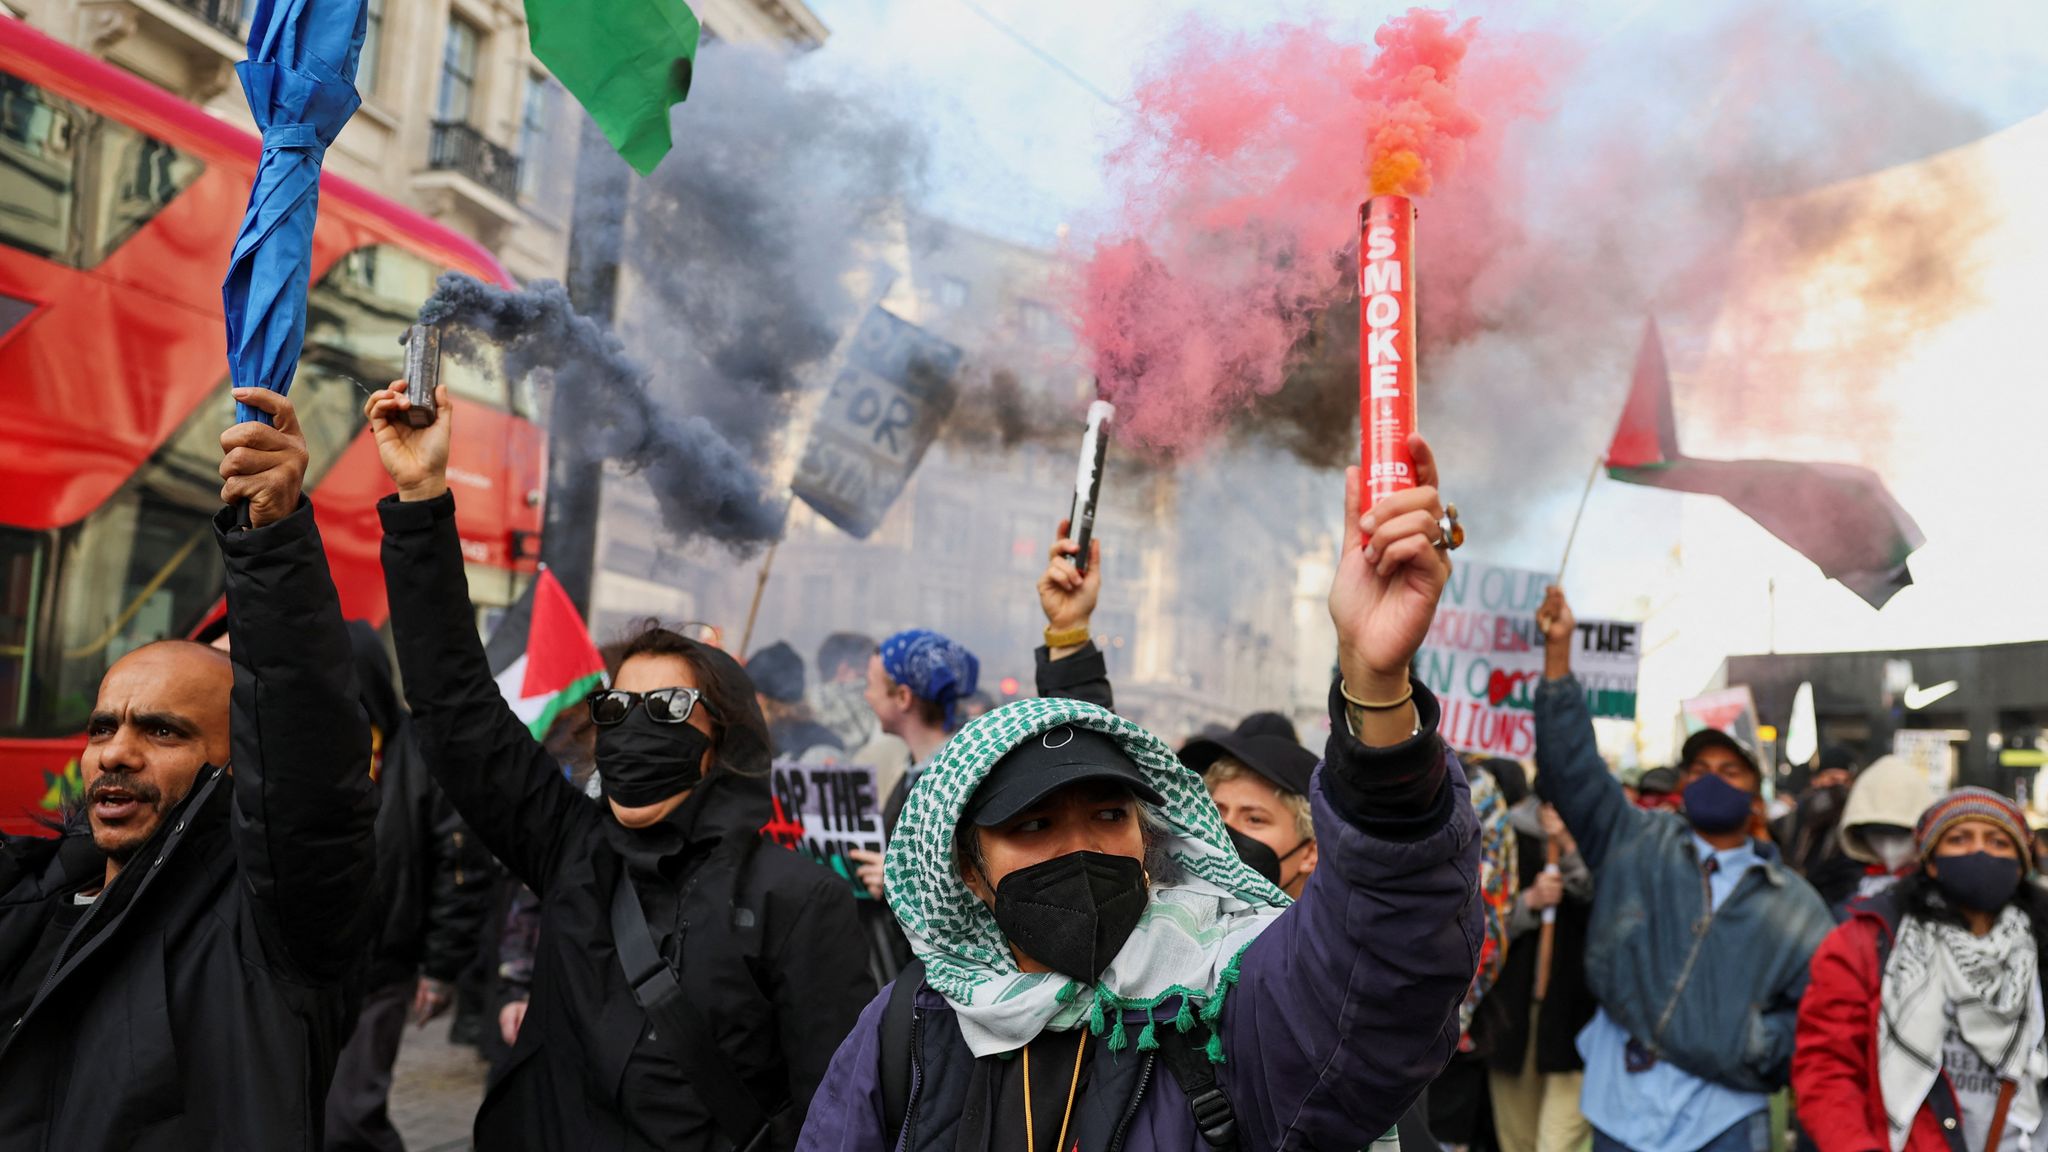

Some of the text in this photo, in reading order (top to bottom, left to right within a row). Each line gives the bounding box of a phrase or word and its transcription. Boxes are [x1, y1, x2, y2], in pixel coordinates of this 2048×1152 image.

[1364, 225, 1402, 398] SMOKE
[1370, 462, 1408, 478] RED
[1576, 622, 1636, 653] THE
[810, 770, 876, 833] THE
